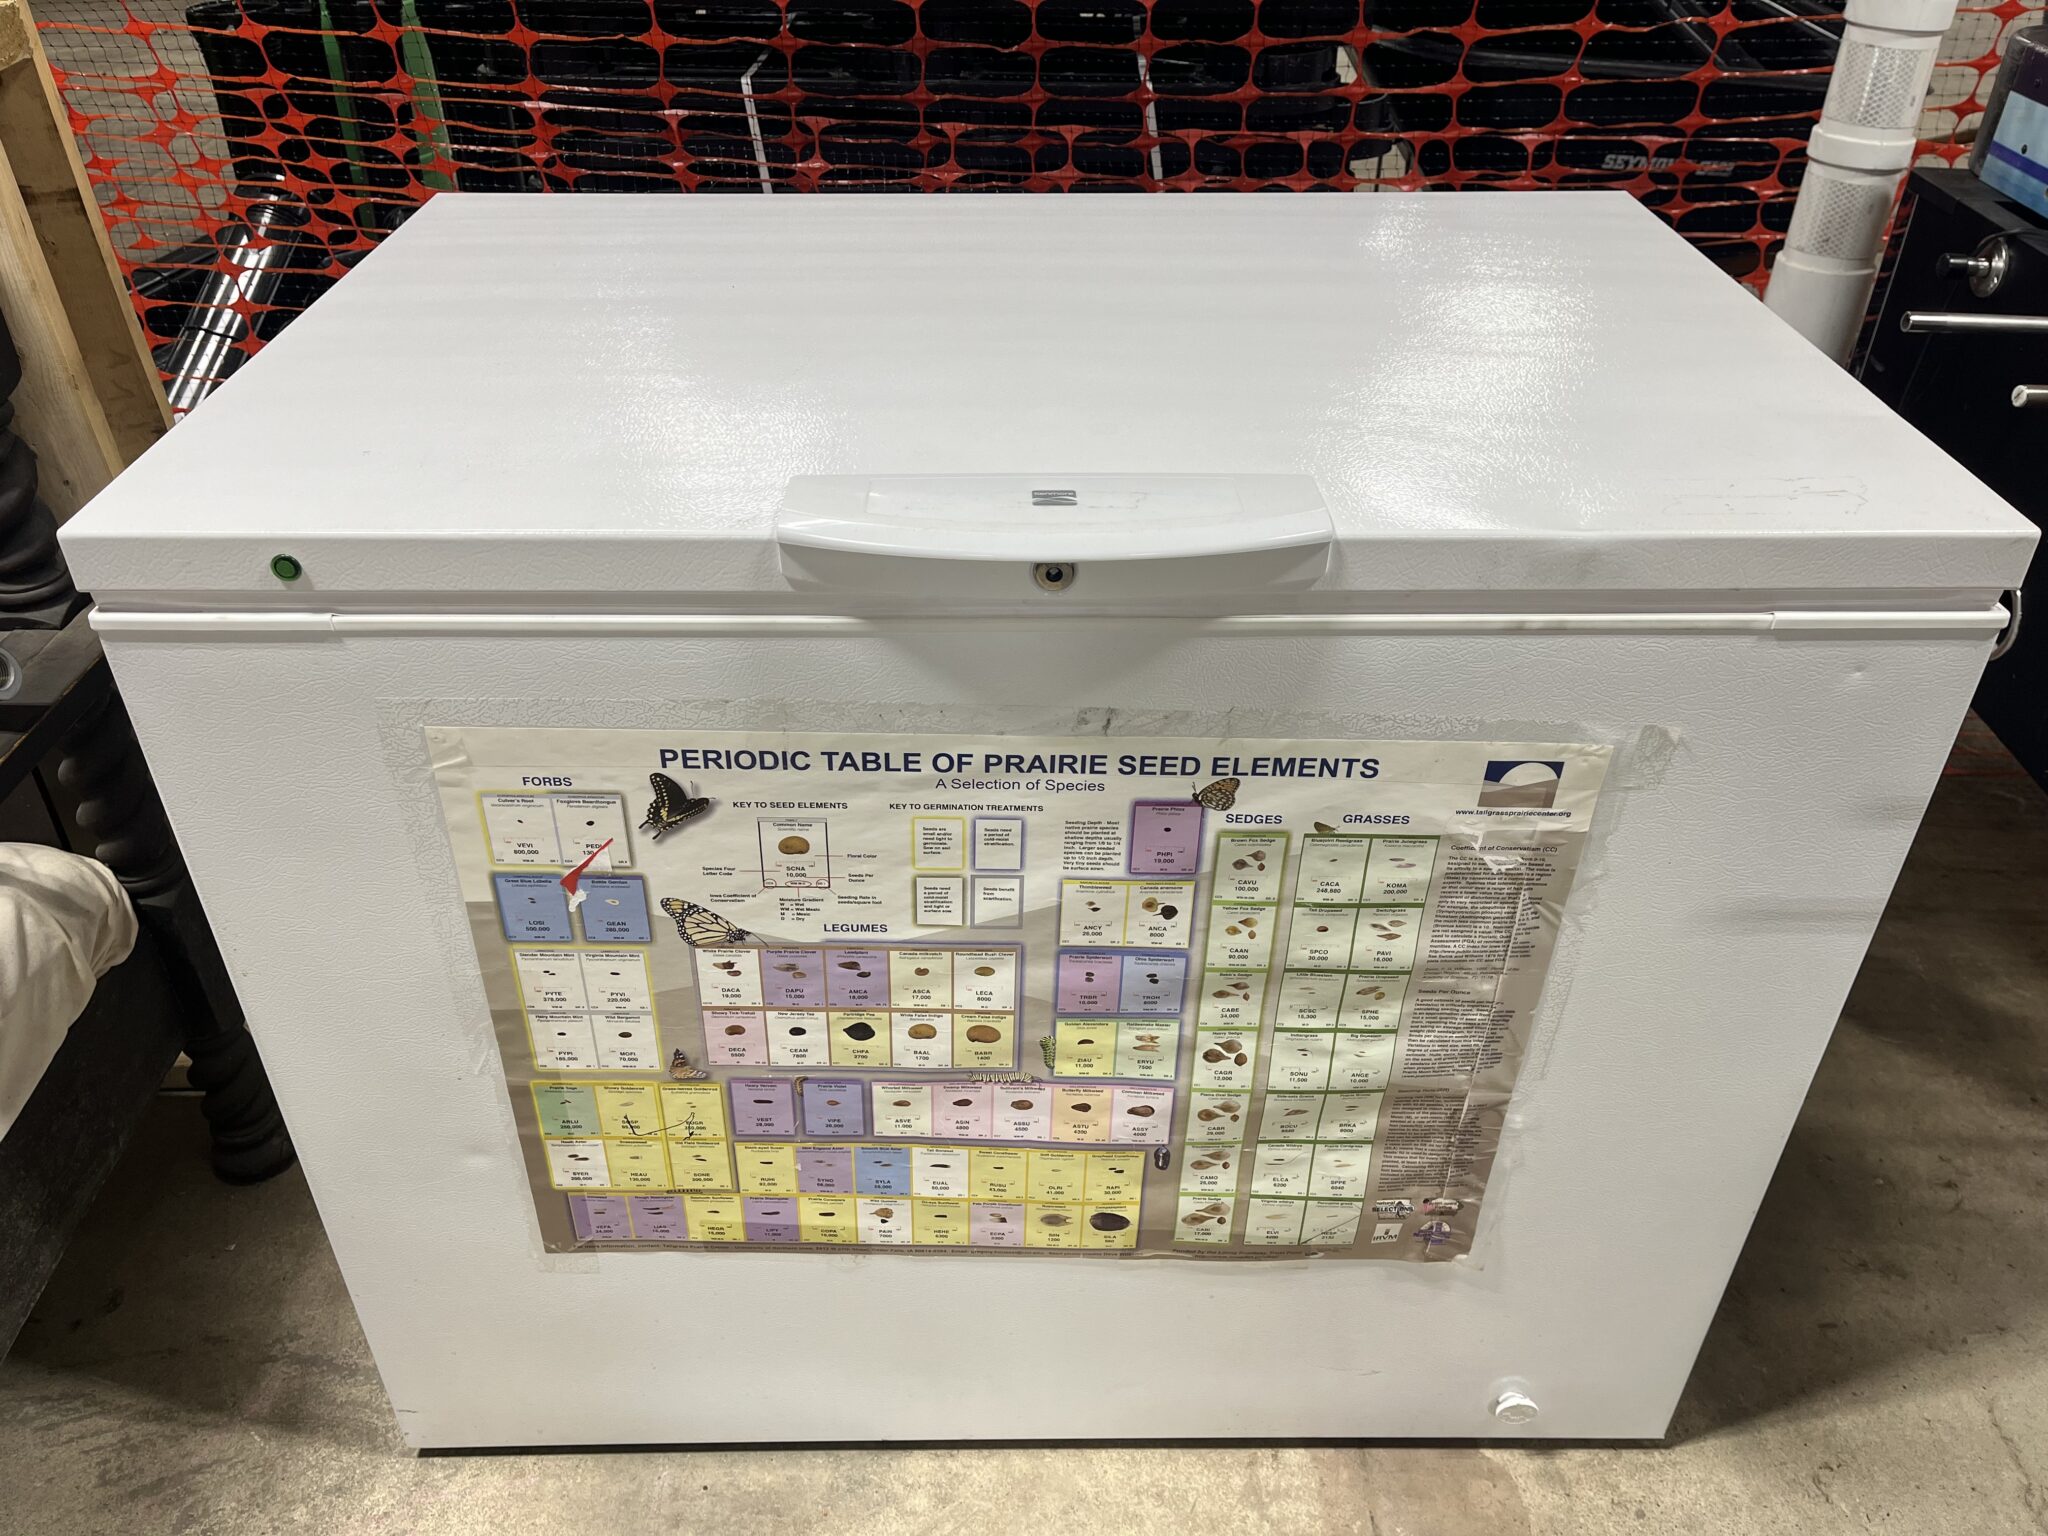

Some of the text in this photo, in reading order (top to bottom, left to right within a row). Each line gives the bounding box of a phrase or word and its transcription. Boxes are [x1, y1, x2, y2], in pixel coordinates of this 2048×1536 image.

[1600, 153, 1698, 173] SEYMO
[659, 749, 1380, 779] PERIODIC TABLE OF PRAIRIE SEED ELEMENTS
[522, 776, 573, 787] FORBS
[935, 778, 1105, 793] A Selection of Species
[755, 801, 768, 809] TO
[797, 802, 848, 810] ELEMENTS
[923, 803, 984, 811] GERMINATION
[986, 804, 1044, 812] TREATMENTS
[1225, 813, 1283, 825] SEDGES
[1342, 813, 1411, 825] GRASSES
[823, 923, 888, 933] LEGUMES
